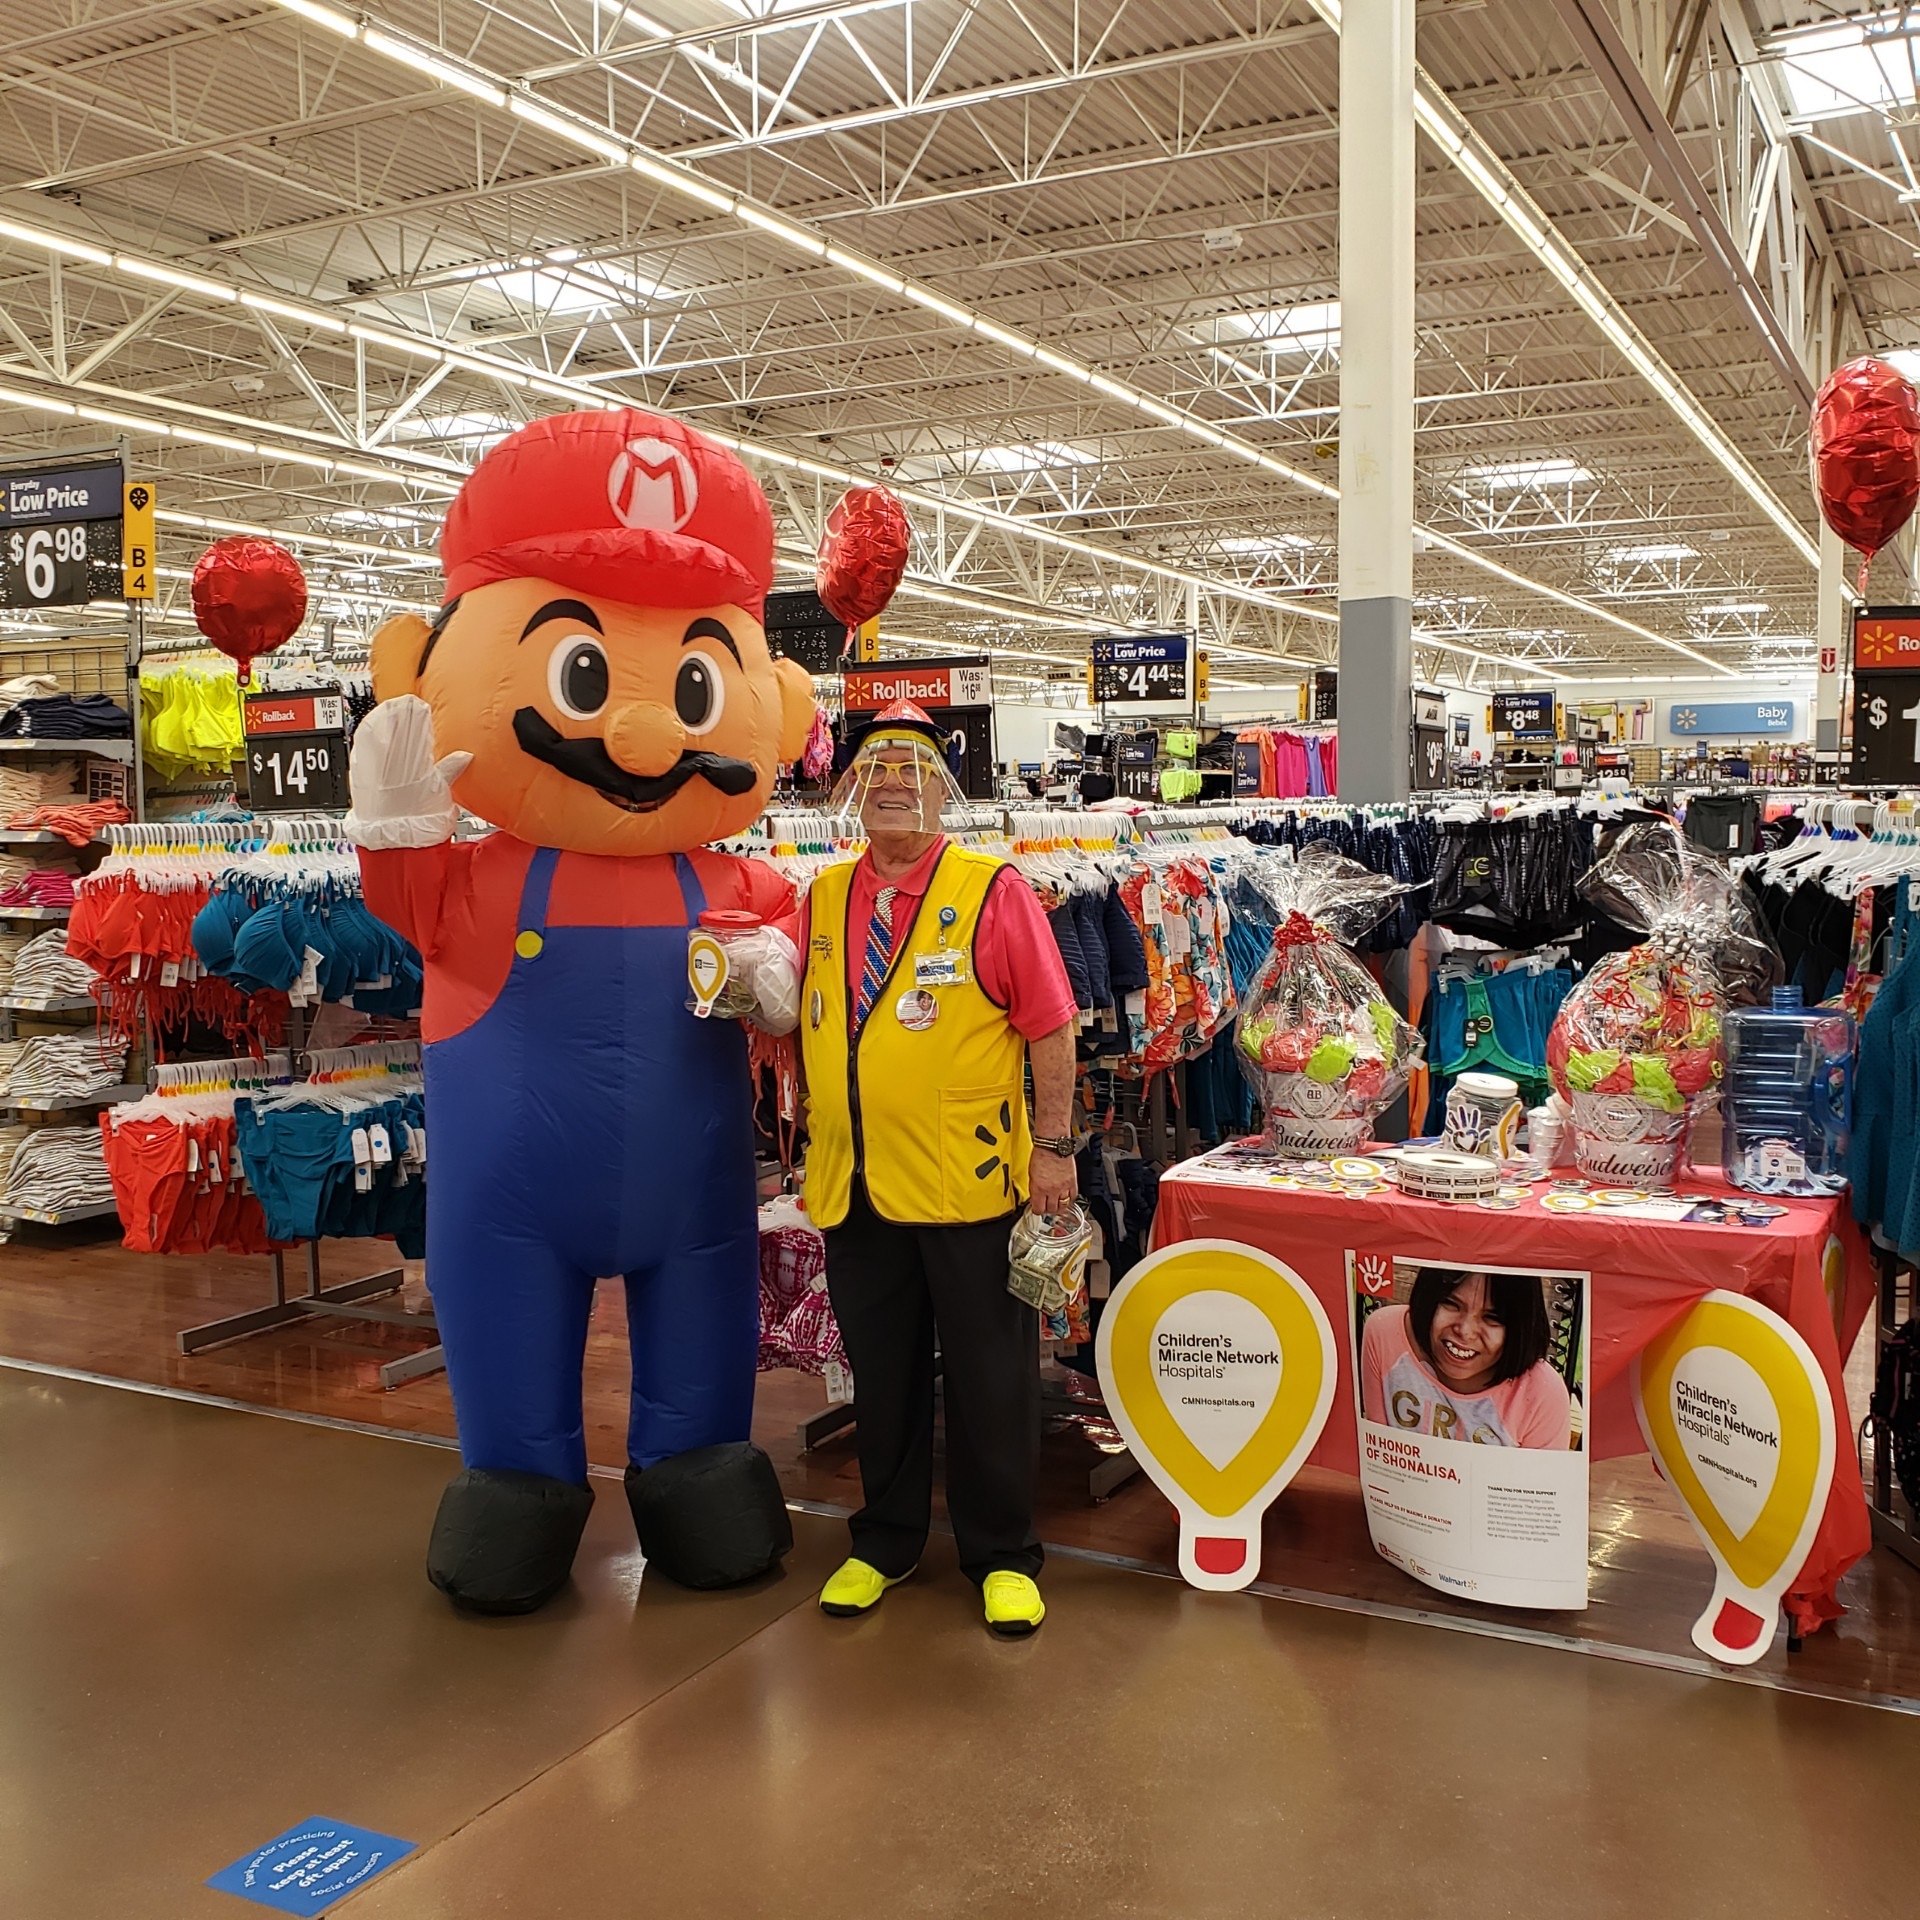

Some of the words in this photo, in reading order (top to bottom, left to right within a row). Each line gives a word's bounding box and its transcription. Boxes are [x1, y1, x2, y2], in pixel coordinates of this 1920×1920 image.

[10, 480, 40, 491] Everyday
[616, 454, 687, 523] M
[10, 491, 45, 512] Low
[46, 485, 89, 509] Price
[132, 548, 146, 568] B
[133, 574, 146, 591] 4
[1114, 647, 1137, 659] Low
[1138, 646, 1166, 657] Price
[959, 669, 984, 682] Was:
[872, 677, 948, 700] Rollback
[1505, 699, 1521, 707] Low
[1757, 706, 1788, 719] Baby
[262, 710, 296, 722] Rollback
[1157, 1333, 1232, 1348] Children's
[1158, 1349, 1213, 1363] Miracle
[1216, 1350, 1279, 1364] Network
[1181, 1397, 1255, 1408] CMNHospitals.org
[1676, 1380, 1738, 1416] Children's
[1677, 1396, 1721, 1426] Miracle
[1724, 1414, 1778, 1448] Network
[1365, 1432, 1377, 1446] IN
[1378, 1436, 1421, 1459] HONOR
[1366, 1447, 1380, 1461] OF
[1382, 1451, 1462, 1485] SHONALISA,
[1697, 1453, 1758, 1488] CMNHospitals.org
[1438, 1573, 1468, 1588] Walmart
[261, 1845, 277, 1857] for
[277, 1830, 336, 1850] practicing
[268, 1868, 306, 1891] keep
[304, 1858, 323, 1870] at
[321, 1838, 354, 1861] least
[271, 1845, 320, 1873] Please
[298, 1871, 324, 1888] 6ft
[321, 1849, 359, 1874] apart
[310, 1881, 345, 1897] social
[345, 1851, 383, 1885] distancing
